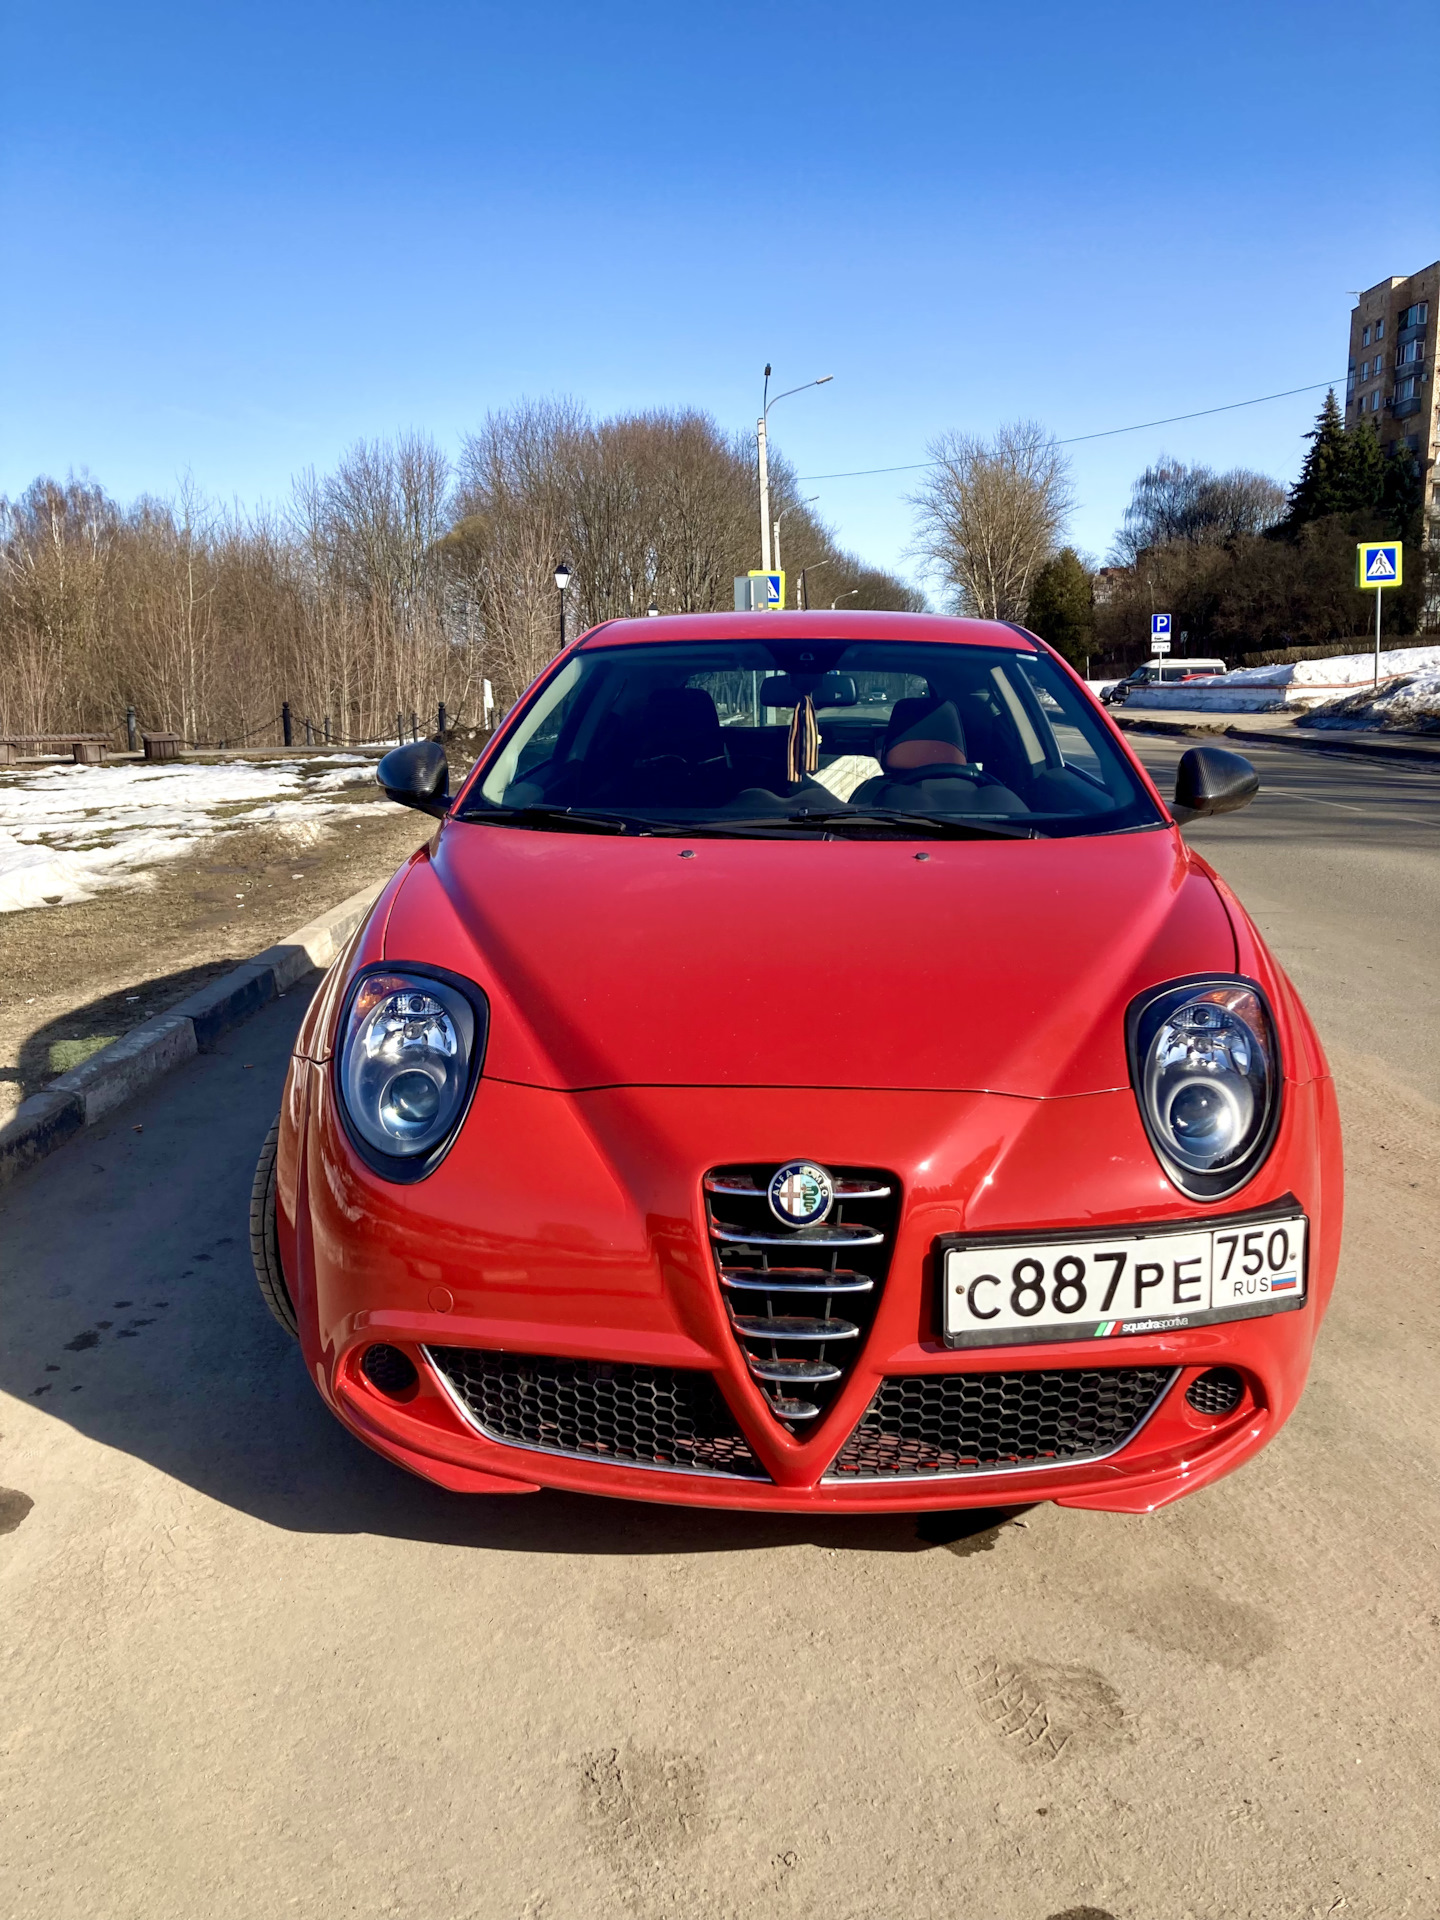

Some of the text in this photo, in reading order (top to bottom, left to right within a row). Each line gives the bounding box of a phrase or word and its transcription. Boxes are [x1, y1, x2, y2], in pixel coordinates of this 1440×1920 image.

[1157, 616, 1168, 631] P
[773, 1169, 793, 1196] ALFA
[1217, 1227, 1289, 1281] 750
[1233, 1277, 1269, 1297] RUS
